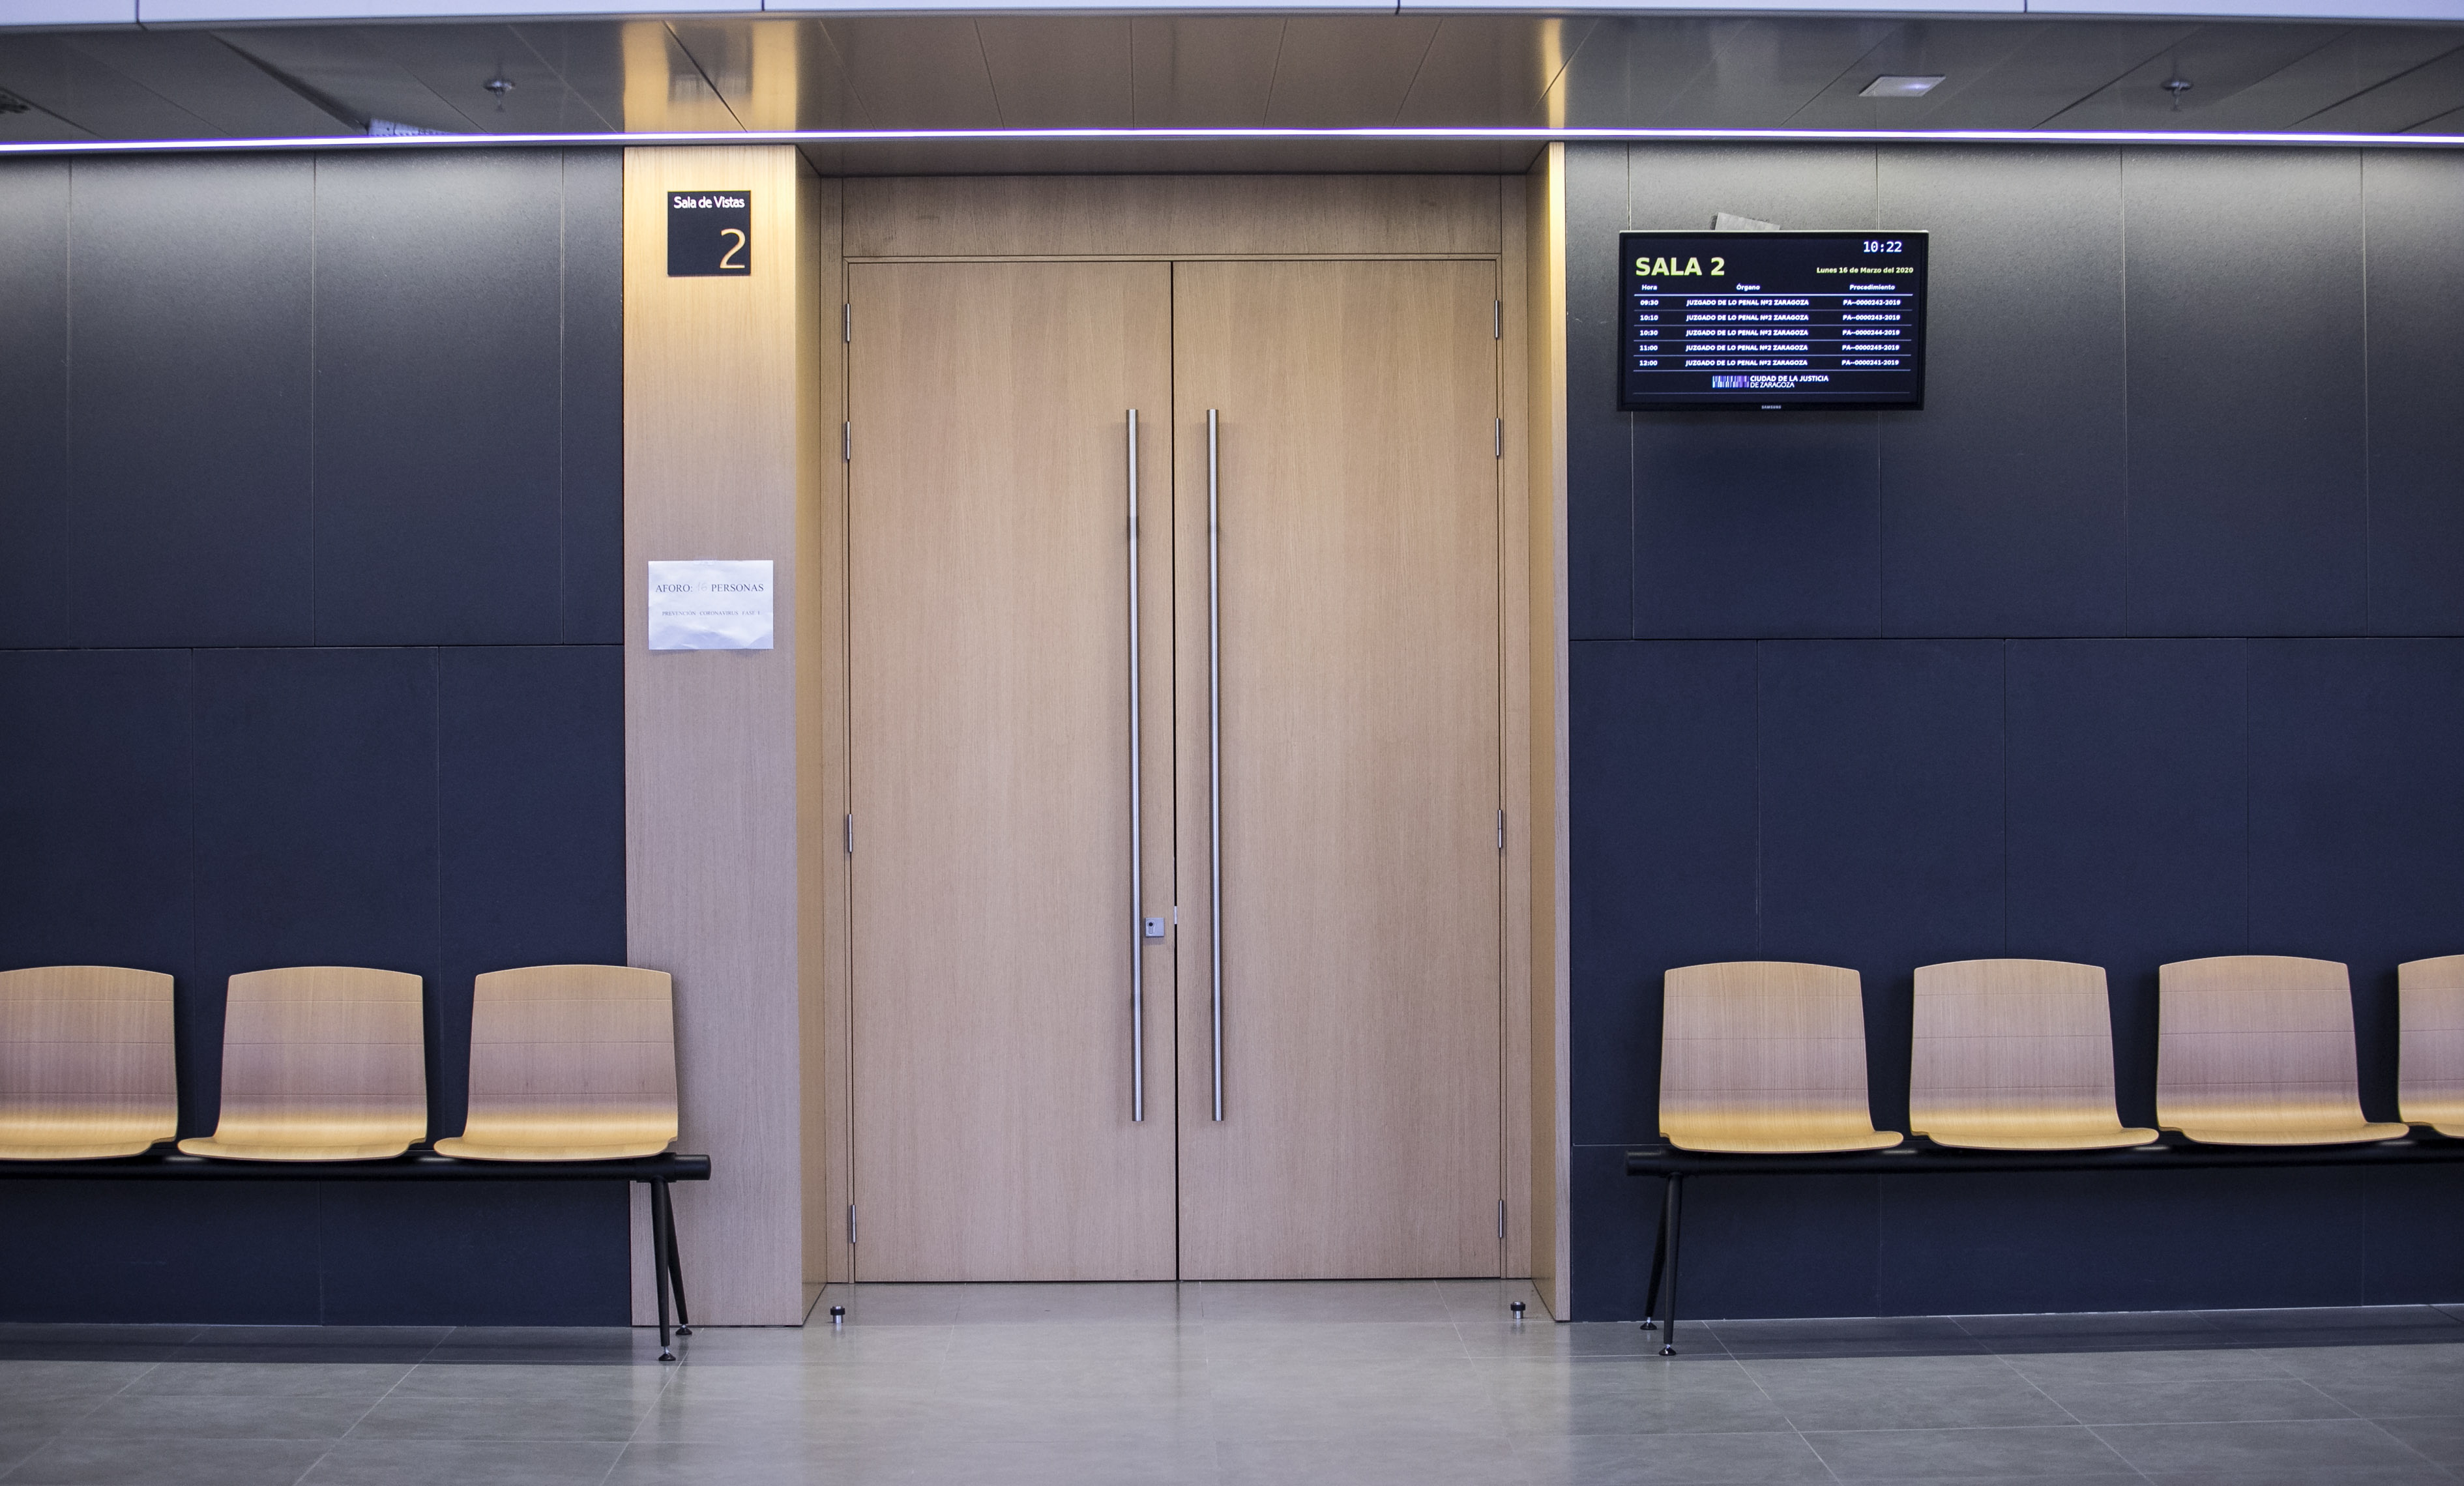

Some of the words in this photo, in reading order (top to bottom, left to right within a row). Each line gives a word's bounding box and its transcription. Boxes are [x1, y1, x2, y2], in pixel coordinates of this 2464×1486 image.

[673, 196, 697, 209] Sala
[698, 196, 712, 209] de
[714, 196, 745, 209] Vistas
[720, 228, 746, 269] 2
[1863, 241, 1902, 253] 10:22
[1635, 257, 1703, 276] SALA
[1710, 257, 1725, 276] 2
[1736, 283, 1760, 291] Órgano
[656, 584, 693, 592] AFORO:
[711, 583, 764, 592] PERSONAS
